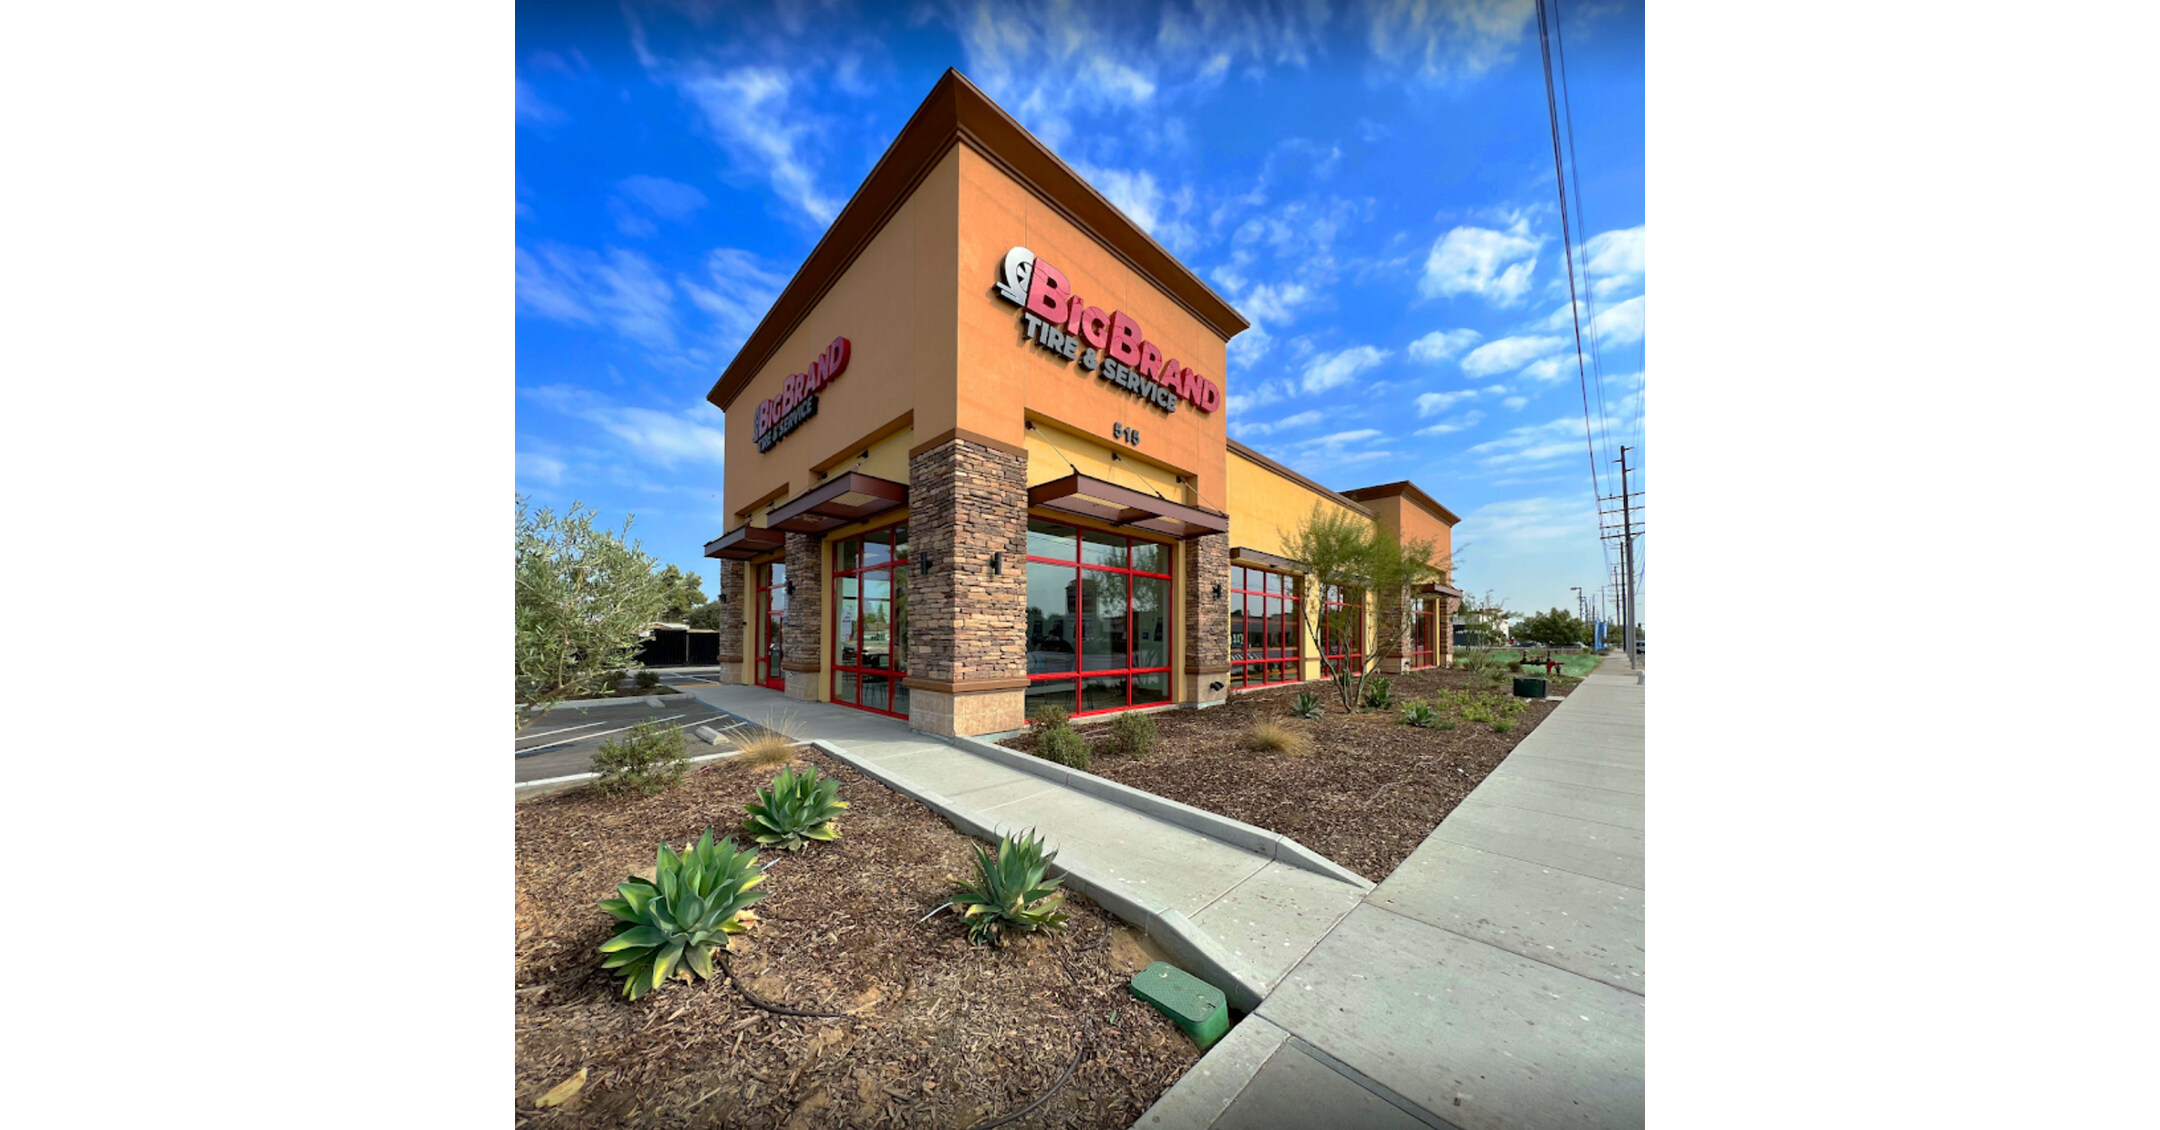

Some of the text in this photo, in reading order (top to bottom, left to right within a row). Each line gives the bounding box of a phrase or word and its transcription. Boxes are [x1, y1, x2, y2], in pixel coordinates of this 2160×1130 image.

[1024, 312, 1179, 414] TIRE & SERVICE
[779, 396, 818, 437] SERVICE
[1113, 422, 1140, 446] 515
